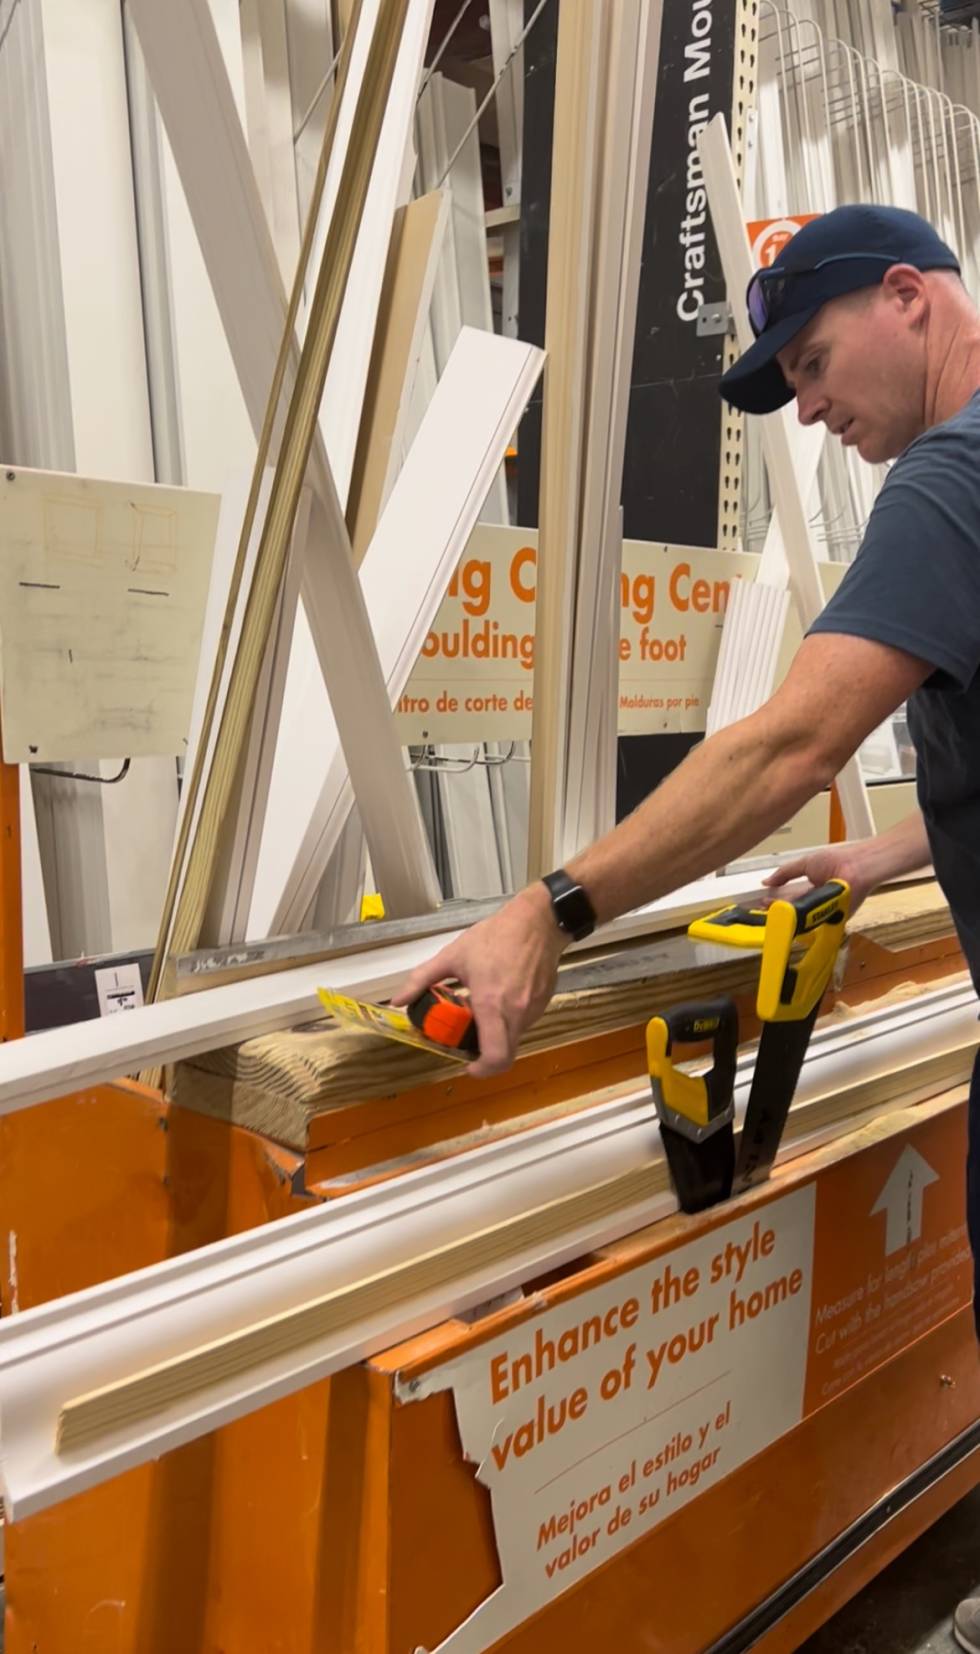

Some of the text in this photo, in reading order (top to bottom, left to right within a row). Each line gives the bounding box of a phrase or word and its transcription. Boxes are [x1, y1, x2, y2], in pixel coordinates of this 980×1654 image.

[676, 93, 709, 322] Craftsman
[640, 627, 687, 662] foot
[670, 562, 742, 613] Cen
[436, 691, 458, 713] de
[465, 694, 507, 712] corte
[667, 698, 683, 710] por
[489, 1221, 776, 1405] Enhance the style
[491, 1267, 803, 1472] value of your home
[536, 1401, 732, 1552] Mejora el estilo y el
[544, 1445, 721, 1579] valor de su hogar
